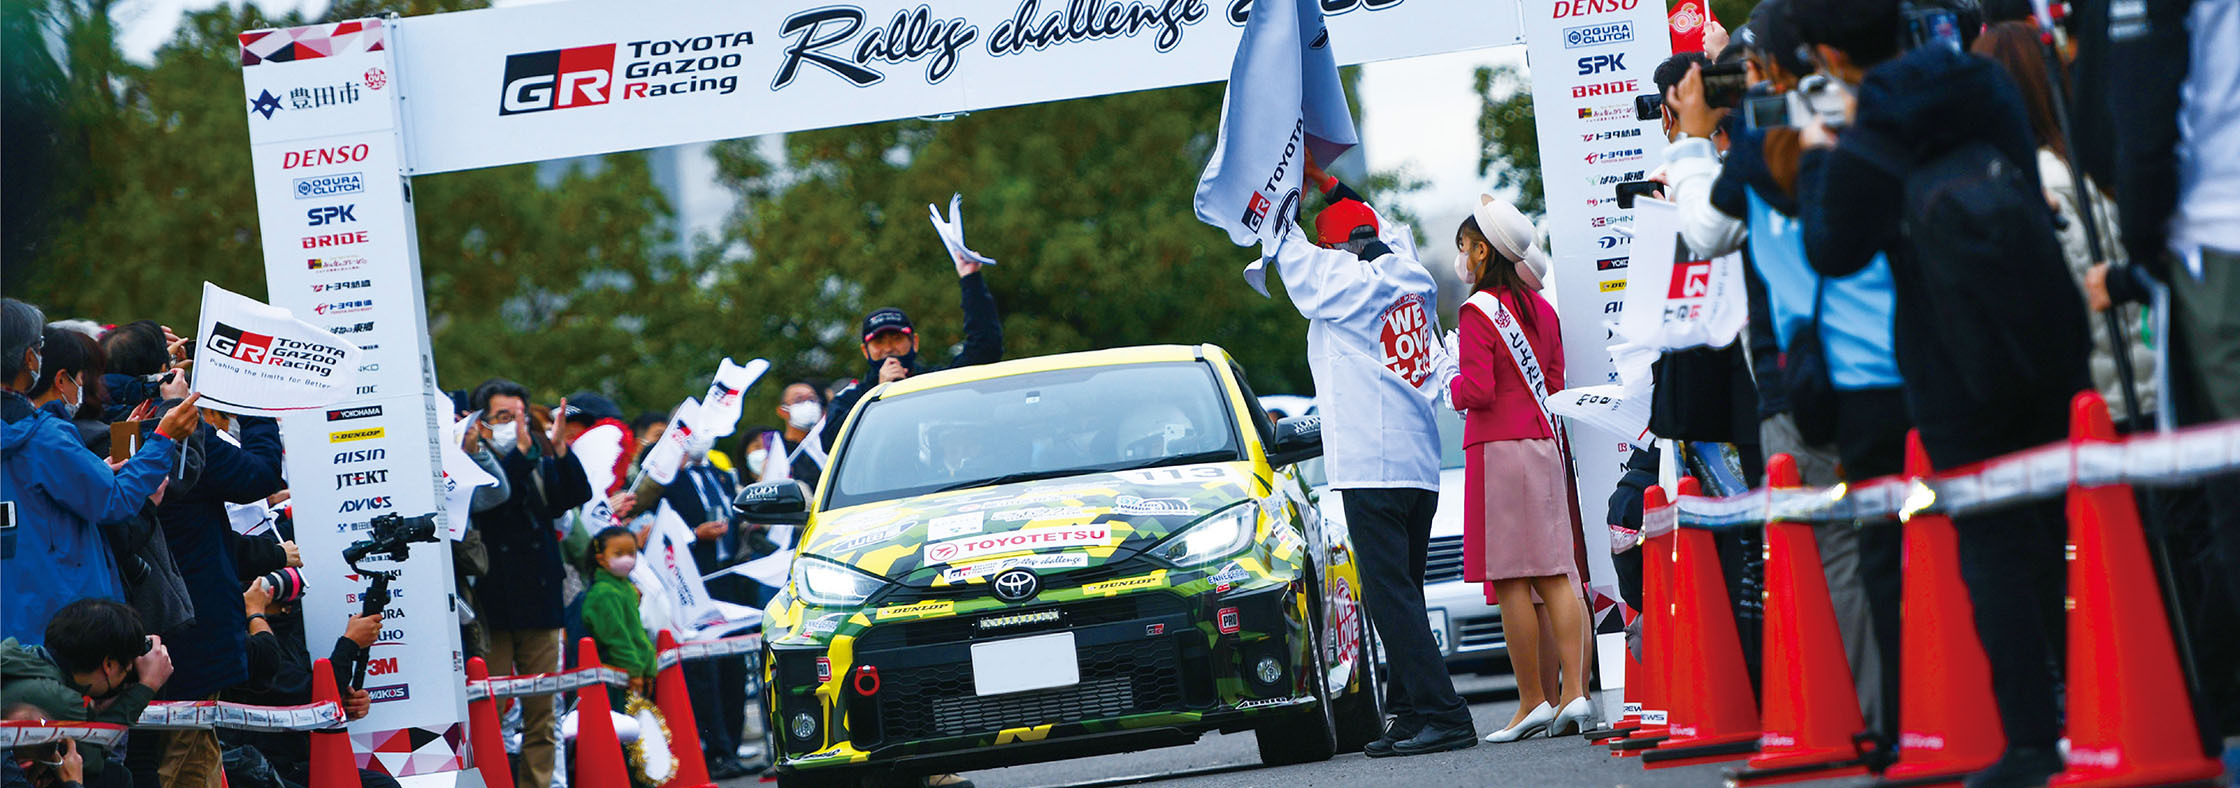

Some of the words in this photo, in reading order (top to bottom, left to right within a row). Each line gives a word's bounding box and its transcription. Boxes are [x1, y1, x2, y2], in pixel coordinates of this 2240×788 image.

[1582, 24, 1629, 36] OGURA
[1583, 32, 1631, 44] CLUTCH
[627, 31, 753, 58] TOYOTA
[771, 4, 977, 91] Rally
[988, 0, 1207, 53] challenge
[625, 53, 741, 79] GAZOO
[1577, 52, 1626, 76] SPK
[289, 82, 360, 111] 豊田市
[503, 68, 611, 113] GR
[624, 76, 738, 99] Racing
[1571, 79, 1639, 98] BRIDE
[282, 143, 369, 169] DENSO
[1264, 118, 1303, 193] TOYOTA
[312, 175, 360, 187] OGURA
[313, 183, 361, 195] CLUTCH
[307, 204, 357, 226] SPK
[1606, 215, 1634, 225] SHIN
[301, 230, 369, 249] BRIDE
[1388, 303, 1424, 335] WE
[209, 333, 267, 363] GR
[277, 337, 346, 359] TOYOTA
[1380, 322, 1430, 366] LOVE
[272, 347, 337, 366] GAZOO
[209, 358, 240, 374] Pushing
[244, 368, 257, 377] the
[261, 371, 284, 382] limits
[289, 376, 301, 384] for
[305, 379, 332, 389] Better
[268, 357, 332, 377] Racing
[340, 407, 381, 418] YOKOHAMA
[340, 430, 381, 439] DUNLOP
[334, 448, 386, 464] AISIN
[336, 469, 389, 491] JTEKT
[1135, 466, 1226, 481] 113
[965, 530, 1105, 552] TOYOTETSU
[1002, 558, 1038, 568] Rally
[1040, 556, 1082, 566] challenge
[1099, 577, 1157, 590] DUNLOP
[892, 603, 949, 615] DUNLOP
[1223, 614, 1237, 627] PRO
[367, 657, 399, 676] 3M
